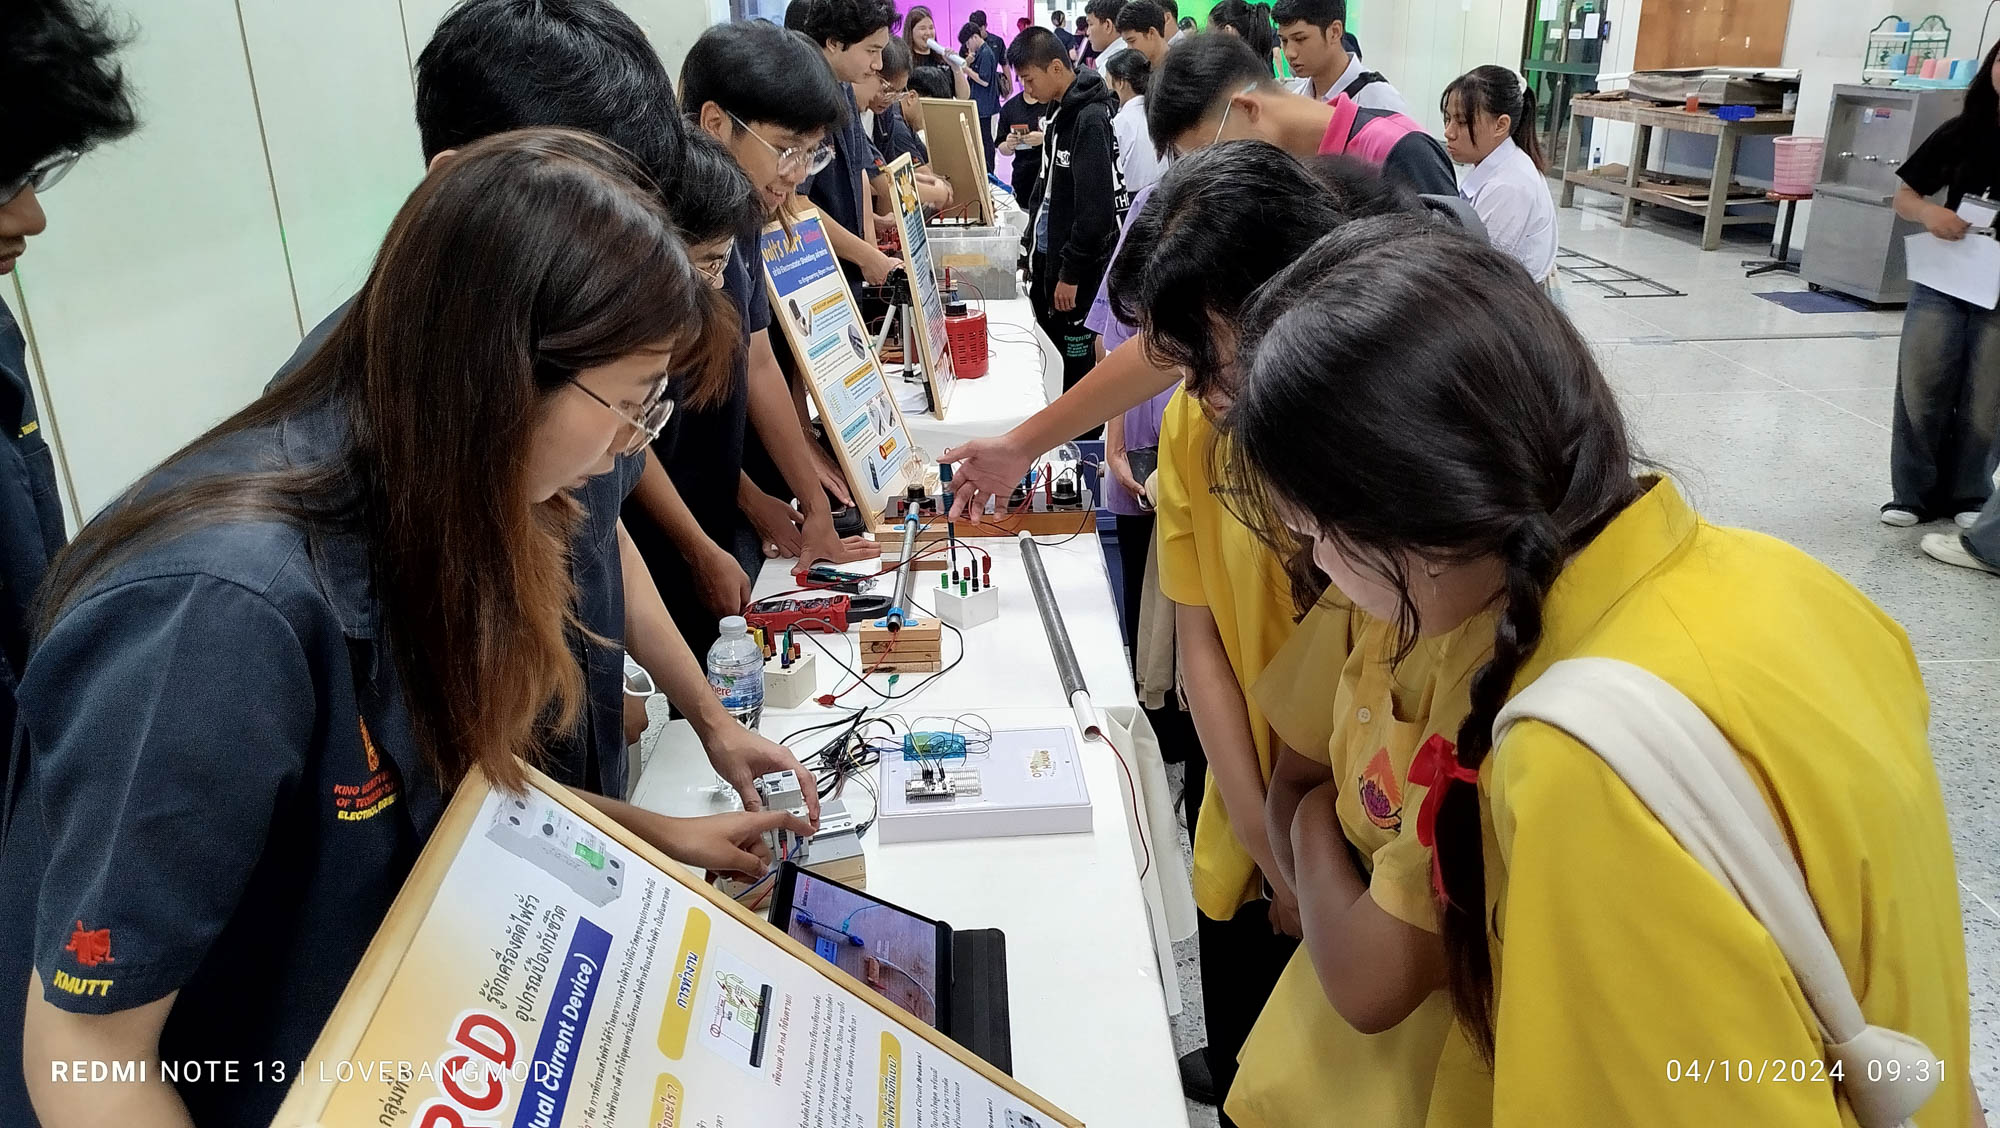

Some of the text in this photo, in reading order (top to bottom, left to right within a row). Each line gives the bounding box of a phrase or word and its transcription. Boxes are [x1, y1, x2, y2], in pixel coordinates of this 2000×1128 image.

[334, 784, 360, 796] KING
[336, 798, 351, 808] OF
[479, 893, 540, 1010] รู้จักเครื่องตัดไฟรั่ว
[515, 905, 567, 1022] อุปกรณ์ป้องกันชีวิต
[677, 951, 698, 1008] การทำงาน
[54, 970, 113, 997] KMUTT
[543, 1020, 576, 1091] Current
[562, 953, 598, 1021] Device)
